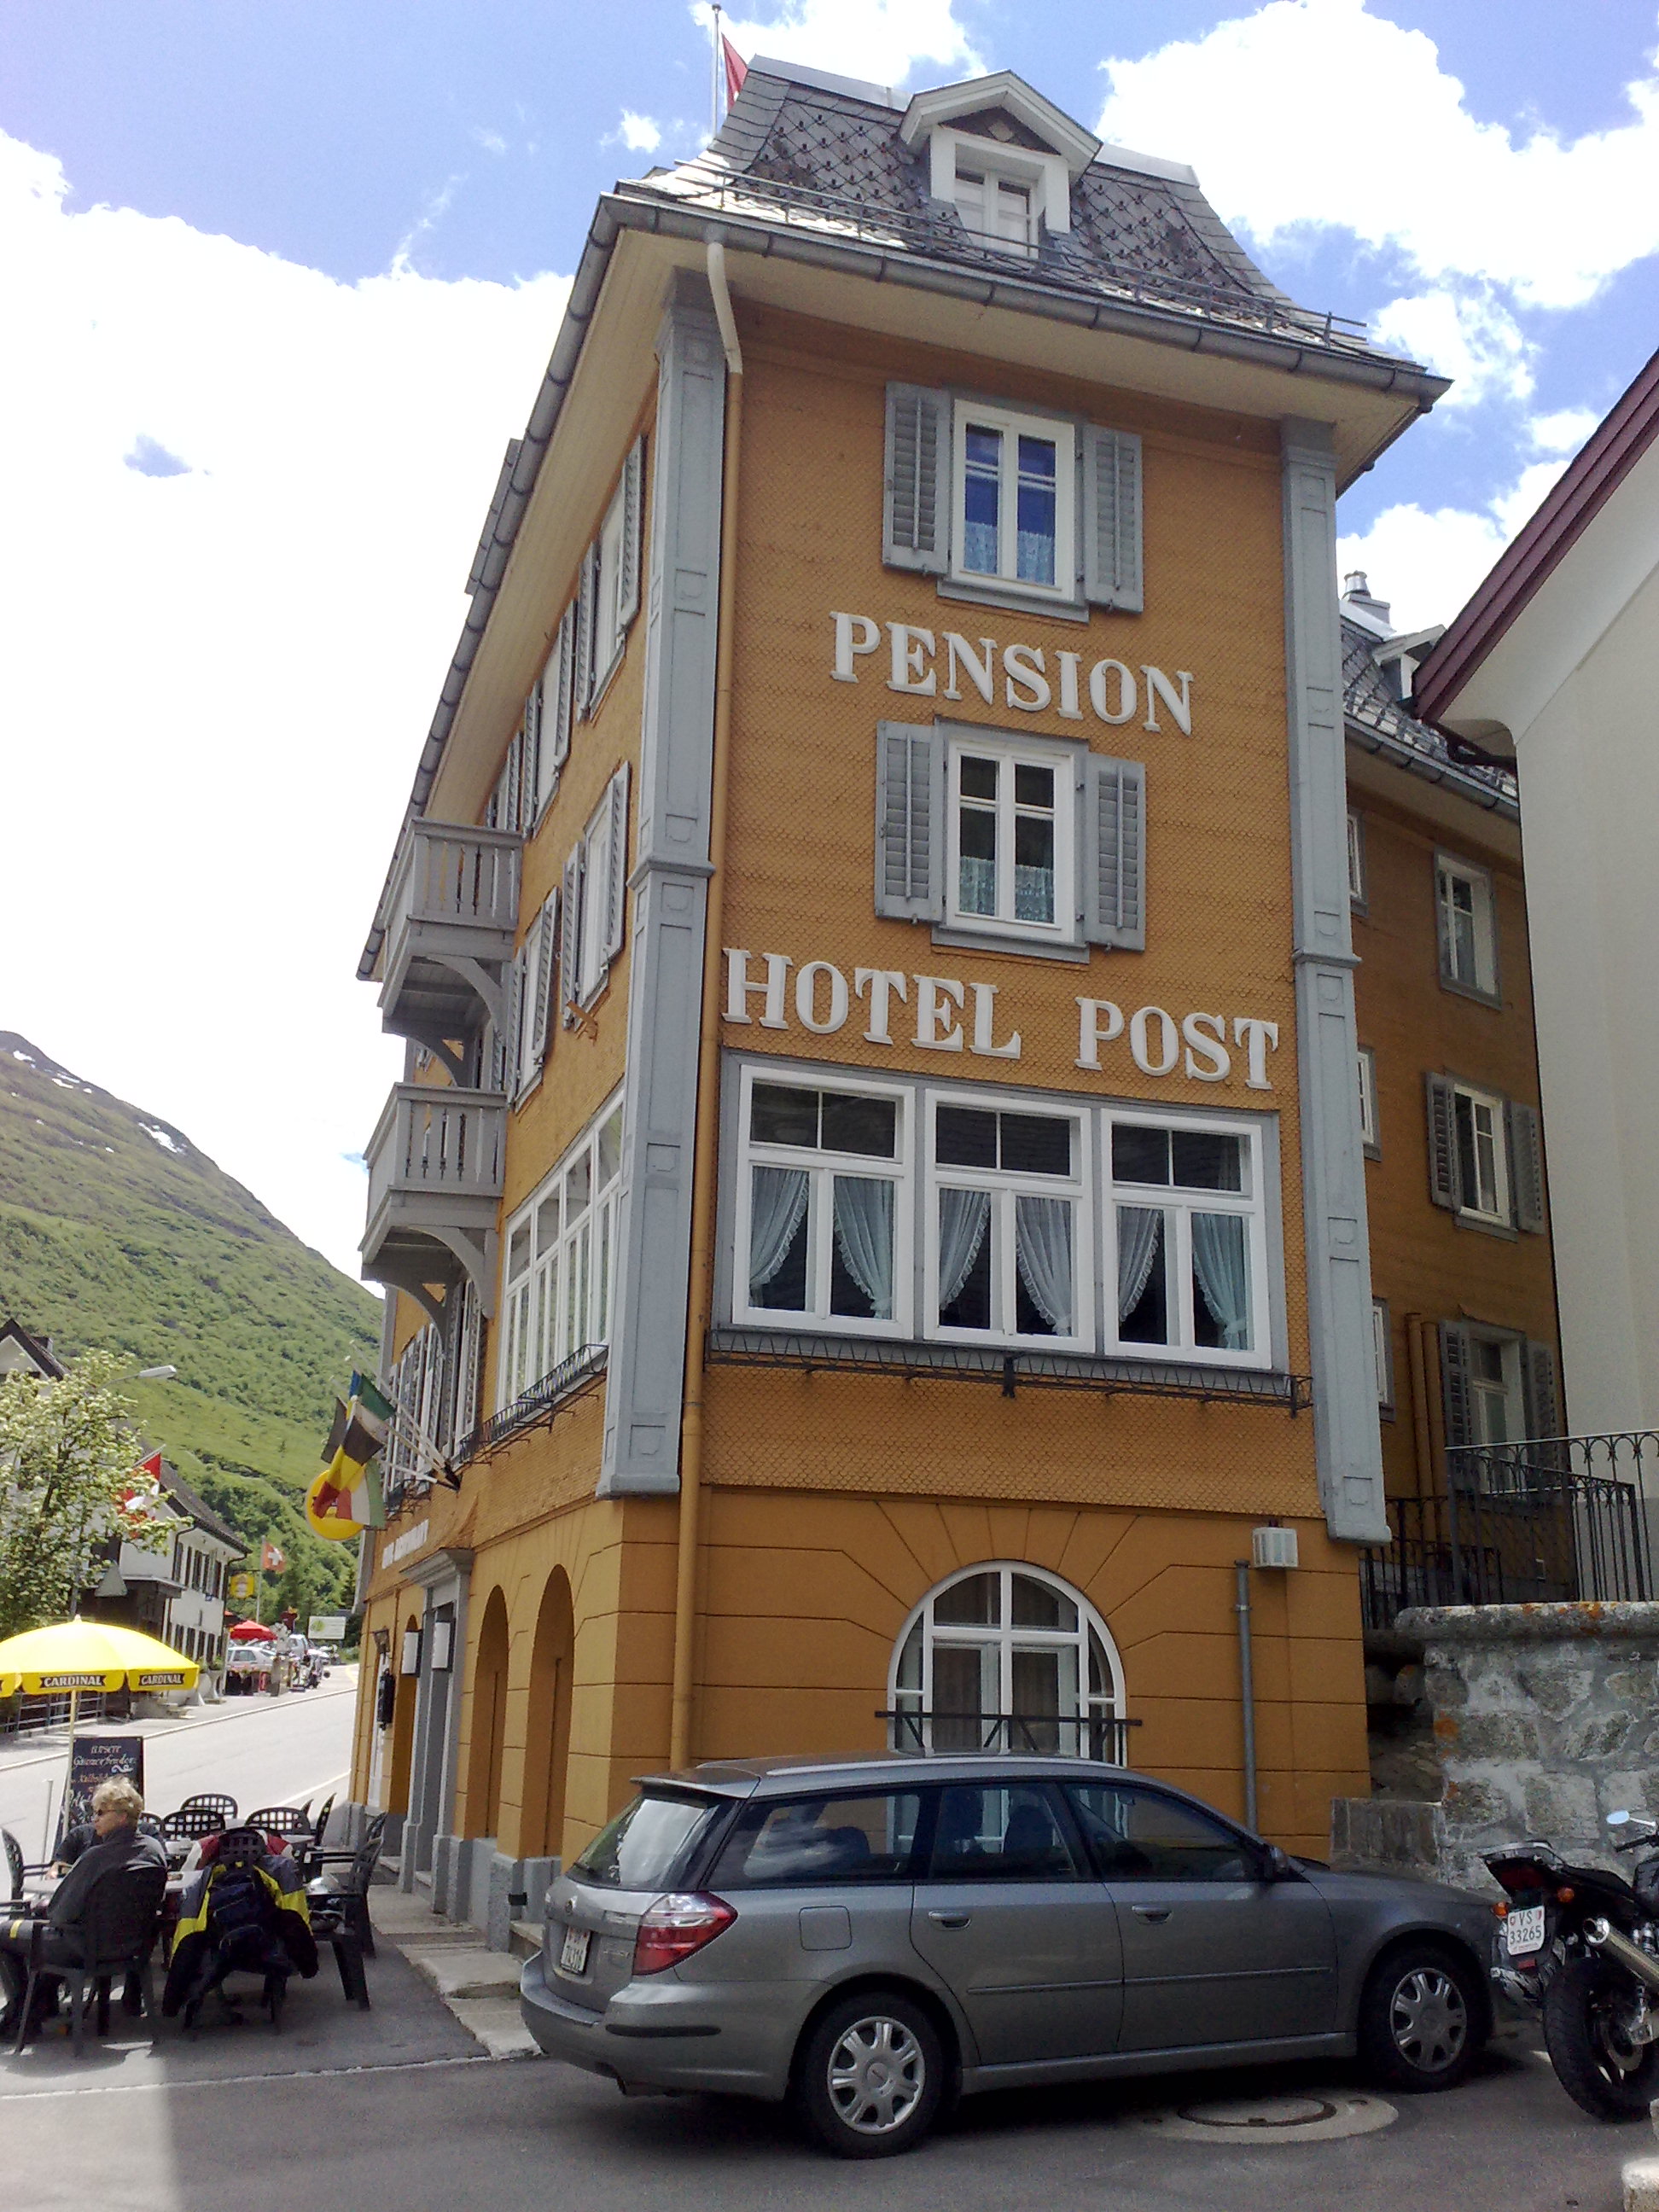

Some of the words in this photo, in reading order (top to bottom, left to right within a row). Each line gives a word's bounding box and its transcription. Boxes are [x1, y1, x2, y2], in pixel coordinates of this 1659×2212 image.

[829, 610, 1194, 736] PENSION
[721, 946, 1022, 1059] HOTEL
[1074, 995, 1279, 1091] POST
[44, 1674, 103, 1687] CARDINAL
[140, 1673, 183, 1686] CARDINAL
[1519, 1910, 1533, 1926] VS
[1510, 1925, 1542, 1945] 33265
